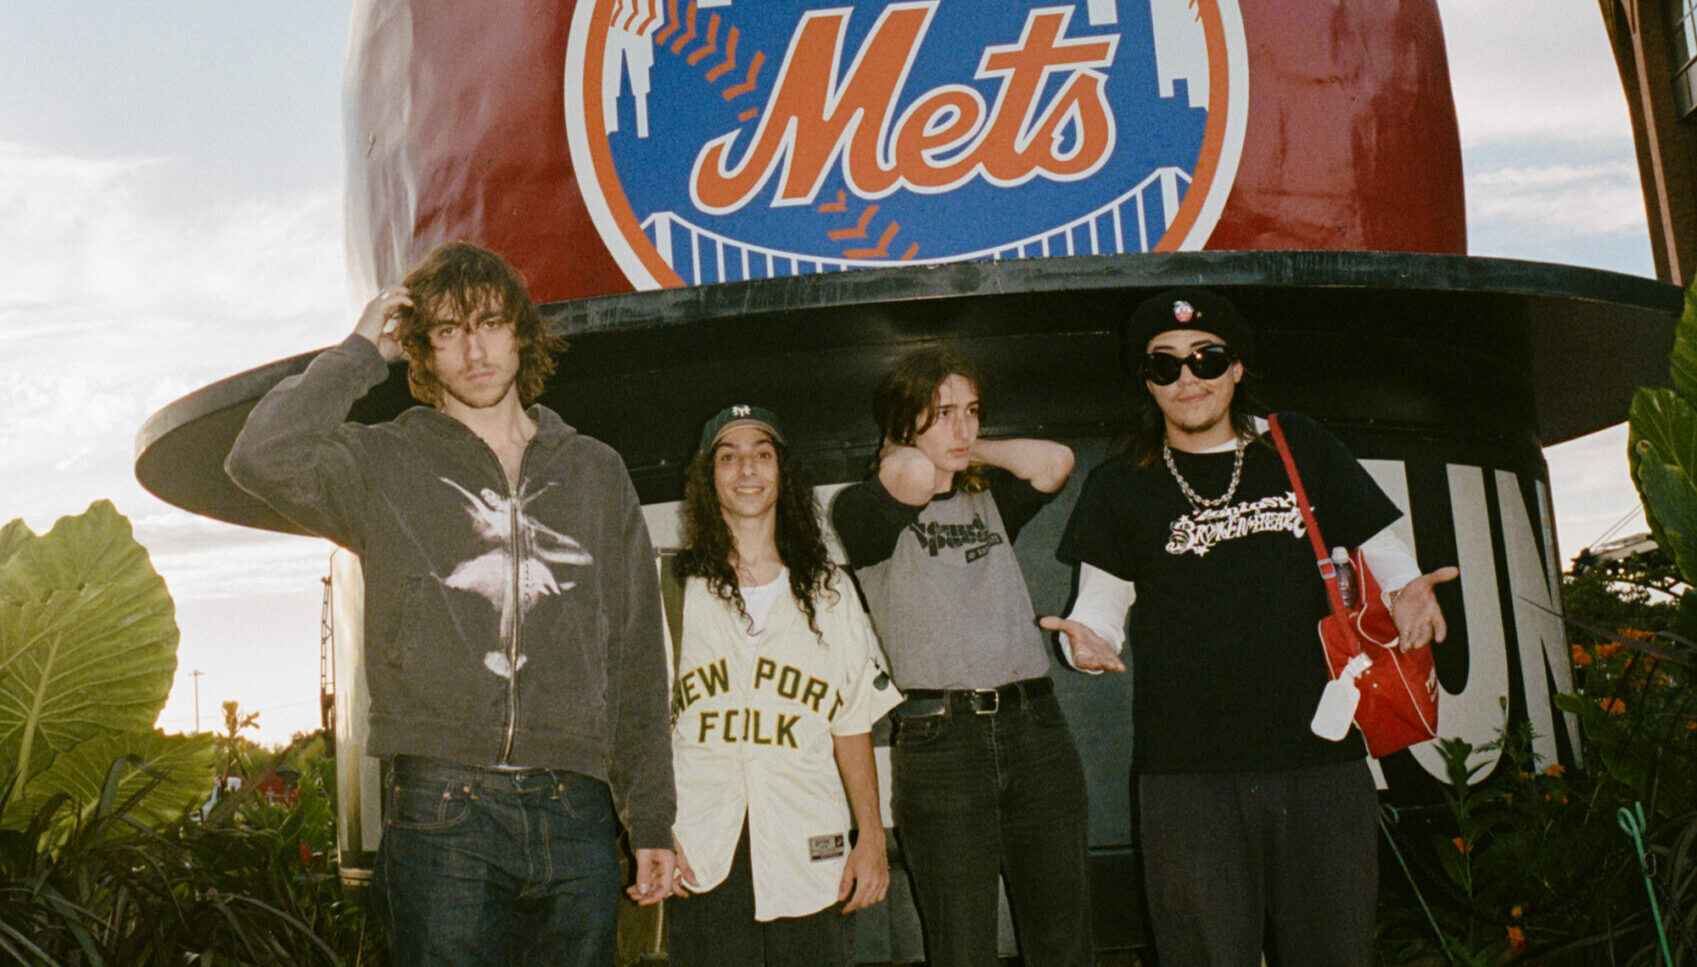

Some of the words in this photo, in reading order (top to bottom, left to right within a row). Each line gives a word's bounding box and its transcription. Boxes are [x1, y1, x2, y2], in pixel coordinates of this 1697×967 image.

[689, 0, 1120, 216] Mets
[754, 656, 844, 722] PORT
[1357, 458, 1585, 790] UN
[698, 708, 802, 749] FOLK
